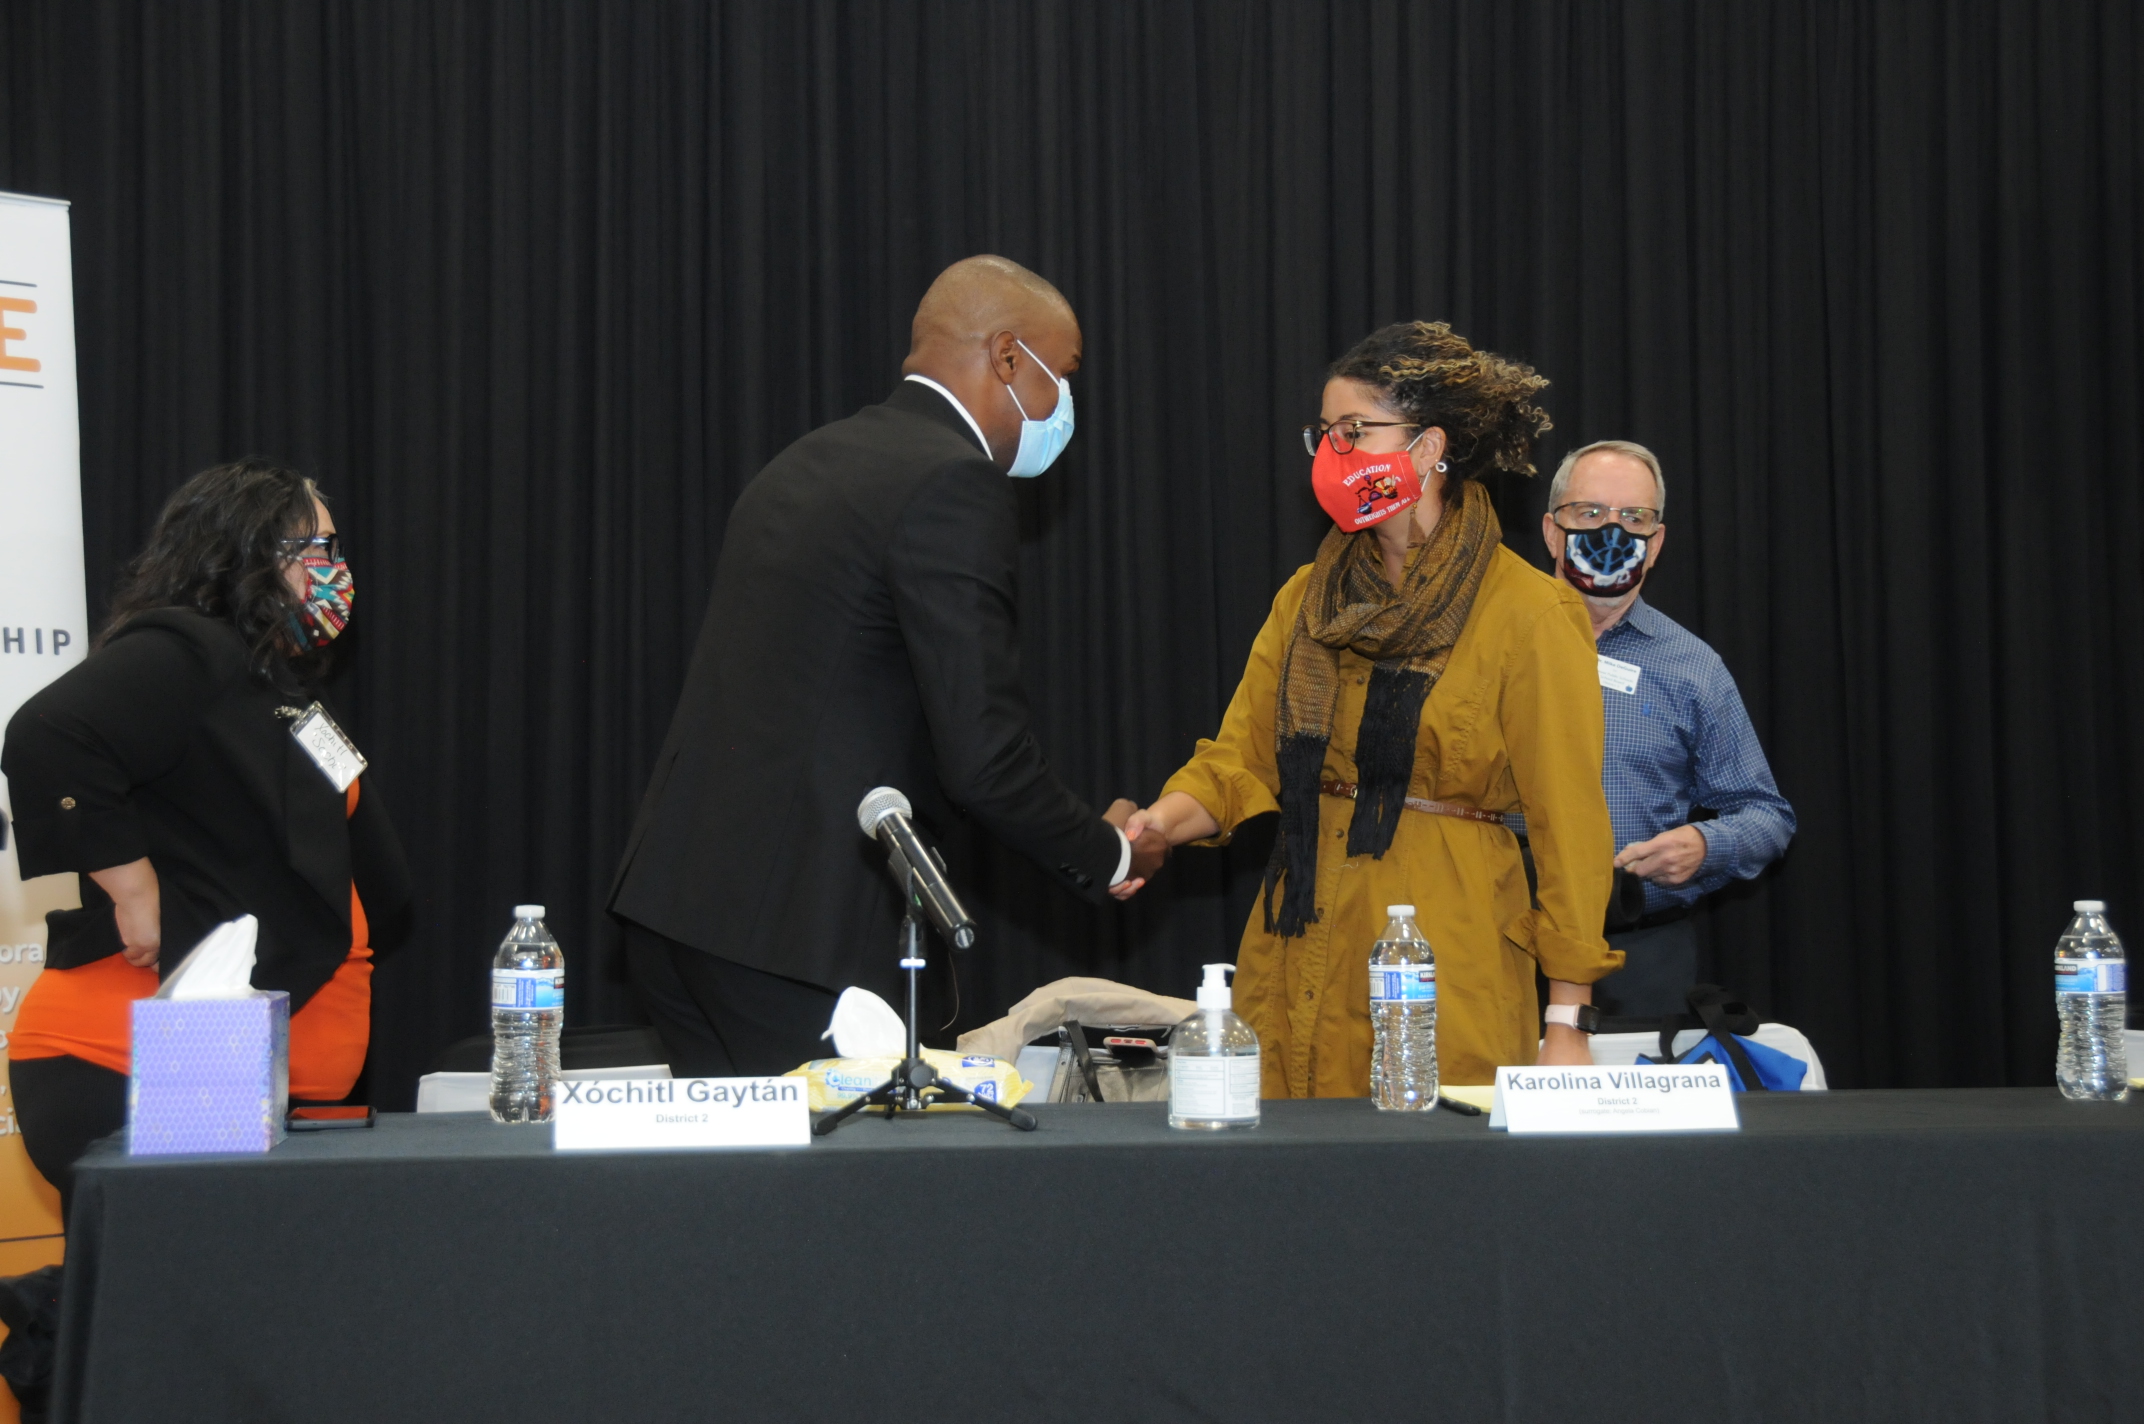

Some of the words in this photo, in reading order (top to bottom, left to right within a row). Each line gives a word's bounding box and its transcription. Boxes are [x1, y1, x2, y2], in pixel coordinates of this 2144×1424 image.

[1342, 464, 1391, 486] EDUCATION
[562, 1080, 674, 1104] Xóchitl
[686, 1078, 798, 1108] Gaytán
[1506, 1071, 1602, 1091] Karolina
[1607, 1071, 1722, 1093] Villagrana
[1597, 1097, 1631, 1105] District
[1632, 1097, 1638, 1105] 2
[655, 1113, 699, 1124] District
[701, 1113, 709, 1124] 2
